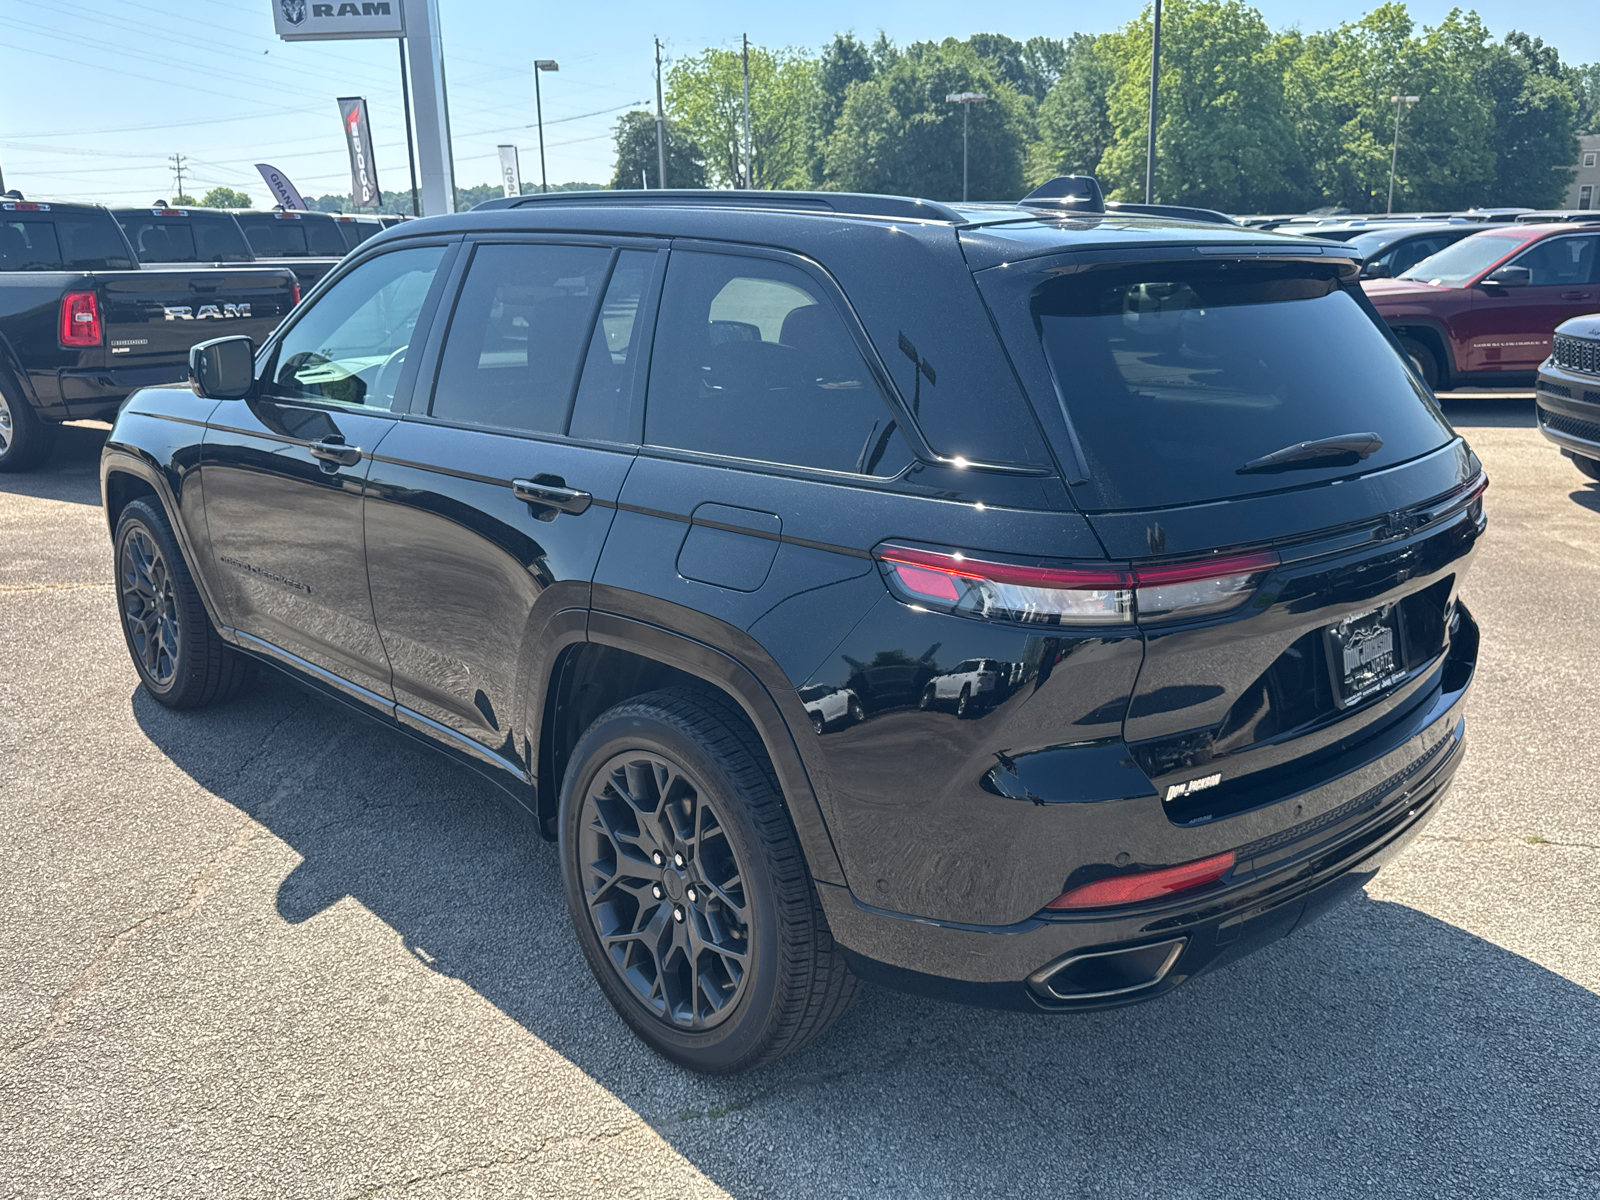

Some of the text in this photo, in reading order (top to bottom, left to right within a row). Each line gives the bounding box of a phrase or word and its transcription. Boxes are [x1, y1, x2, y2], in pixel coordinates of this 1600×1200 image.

[312, 2, 391, 17] RAM
[349, 121, 370, 202] DODGE
[270, 173, 297, 210] GRAND
[505, 167, 518, 198] Jeep
[164, 303, 251, 320] RAM
[1166, 773, 1221, 801] DON JACKSON
